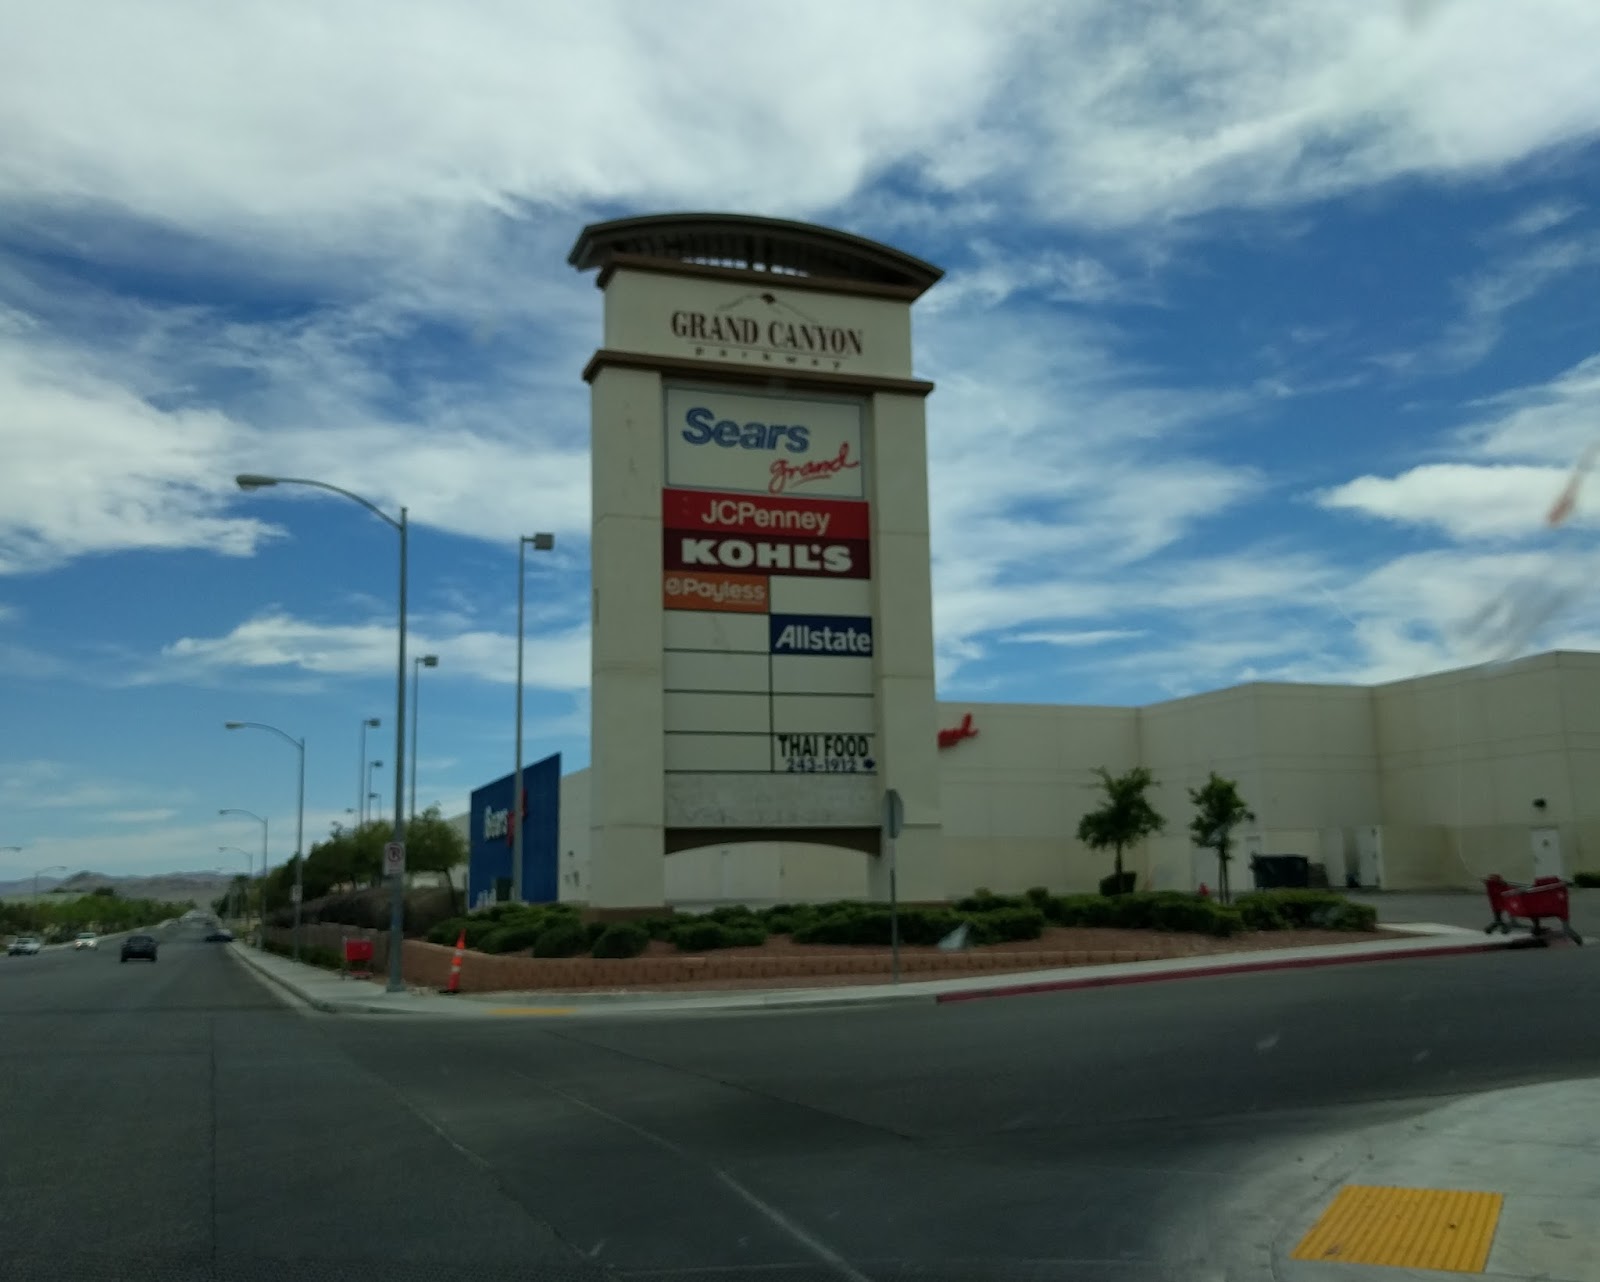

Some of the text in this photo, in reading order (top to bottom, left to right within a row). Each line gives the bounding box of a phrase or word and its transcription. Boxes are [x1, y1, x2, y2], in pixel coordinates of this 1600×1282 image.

[671, 311, 863, 355] GRAND CANYON
[682, 407, 809, 453] Sears
[769, 441, 859, 494] grand
[702, 500, 830, 536] JCPenney
[681, 538, 853, 572] KOHL'S
[682, 577, 765, 602] Payless
[775, 624, 871, 652] Allstate
[778, 735, 868, 757] THAI FOOD
